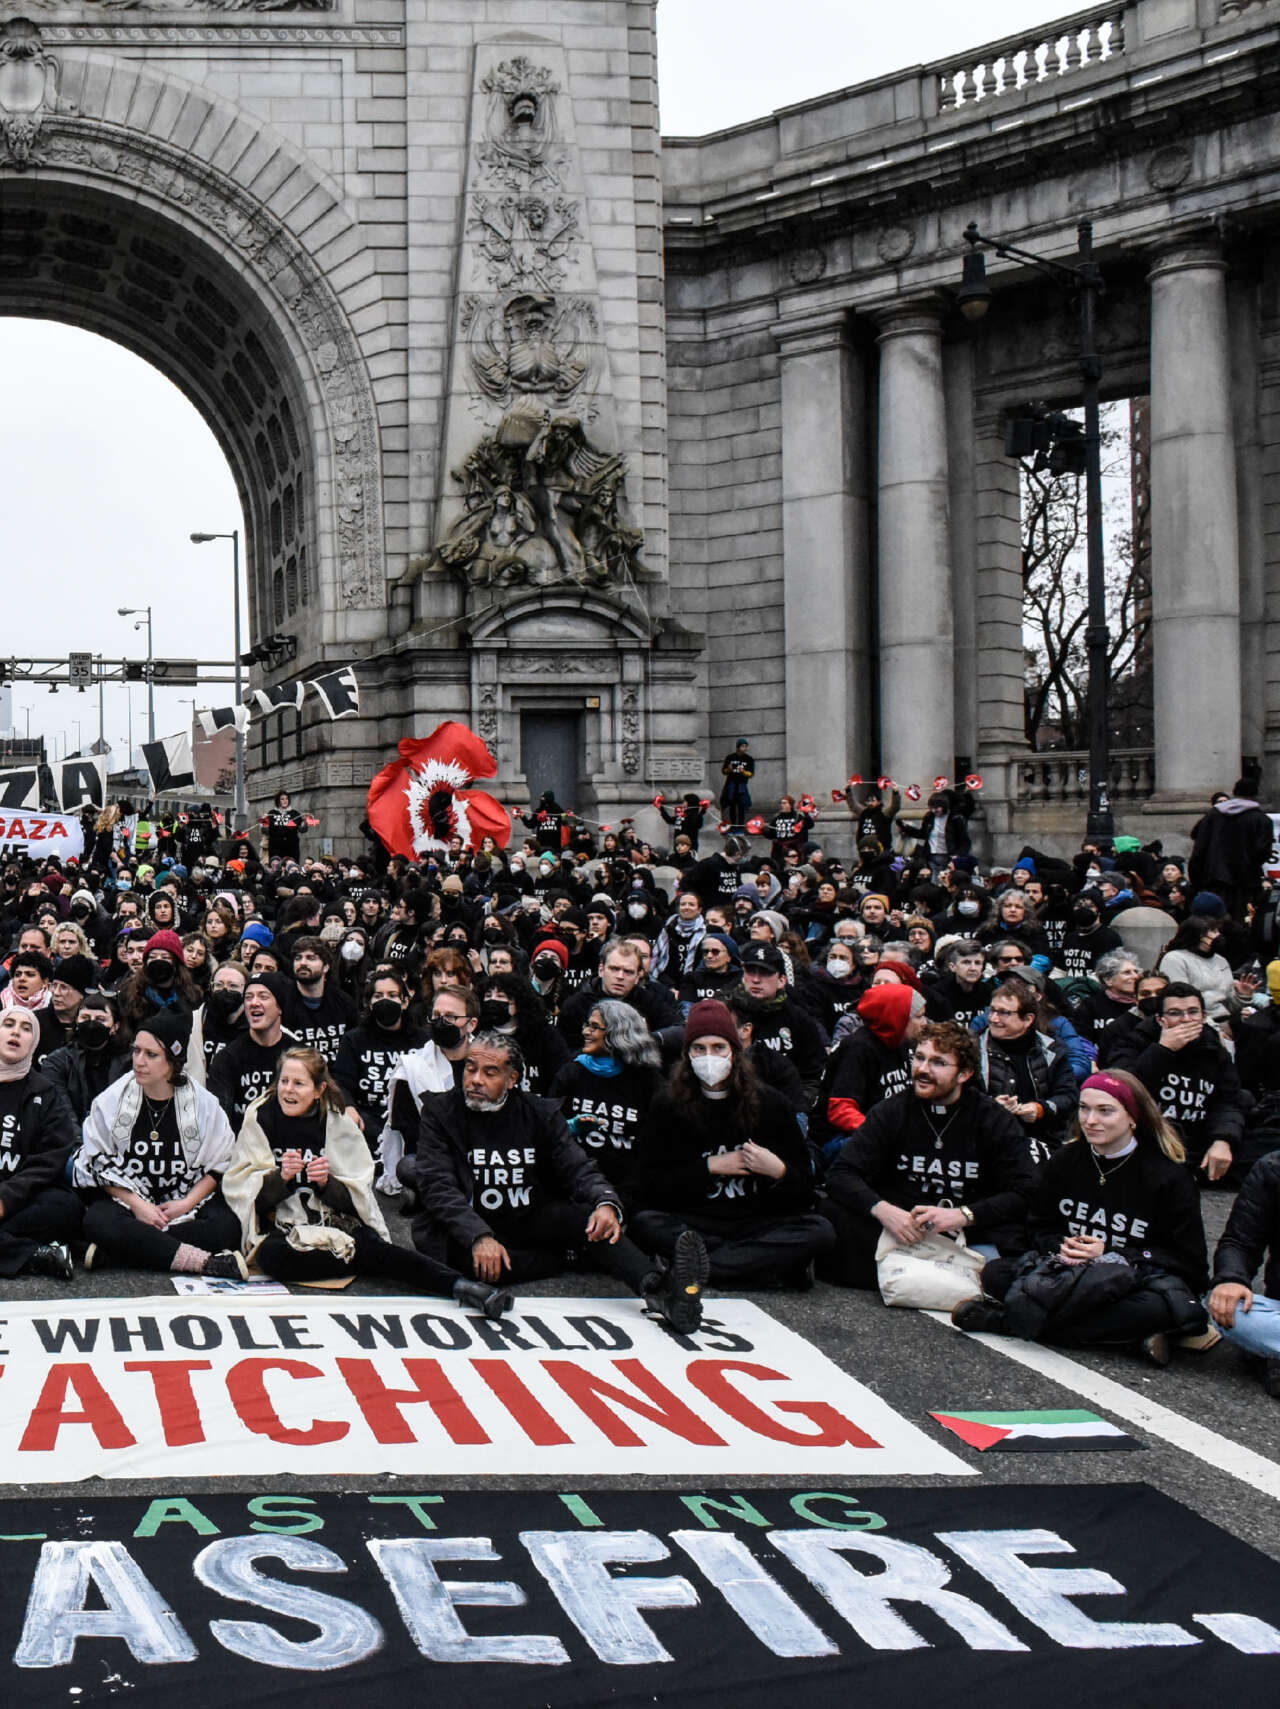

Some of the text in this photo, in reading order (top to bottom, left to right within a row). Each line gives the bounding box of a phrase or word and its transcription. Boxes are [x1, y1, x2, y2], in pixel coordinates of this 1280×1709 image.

[72, 666, 89, 677] 35
[1080, 949, 1092, 960] IN
[1065, 958, 1086, 968] OUR
[1067, 968, 1095, 979] AME
[697, 988, 721, 998] NO
[954, 1011, 972, 1020] OT
[294, 1024, 346, 1042] CEASE
[763, 1036, 793, 1051] WS
[361, 1050, 404, 1066] JEW
[240, 1070, 273, 1088] NOT
[367, 1066, 392, 1081] SA
[1167, 1073, 1191, 1088] OT
[1160, 1086, 1205, 1108] OUR
[572, 1097, 638, 1123] CEASE
[1162, 1105, 1207, 1120] AM
[598, 1117, 625, 1135] RE
[580, 1130, 635, 1149] OW
[128, 1141, 181, 1156] OT I
[471, 1147, 536, 1166] EASE
[128, 1159, 186, 1176] OUR
[897, 1154, 980, 1180] CEASE
[141, 1176, 178, 1188] AM
[476, 1185, 535, 1211] OW
[1059, 1198, 1149, 1239] CEASE
[31, 1313, 325, 1353] WHOLE
[329, 1312, 635, 1352] WORLD
[652, 1317, 756, 1353] IS
